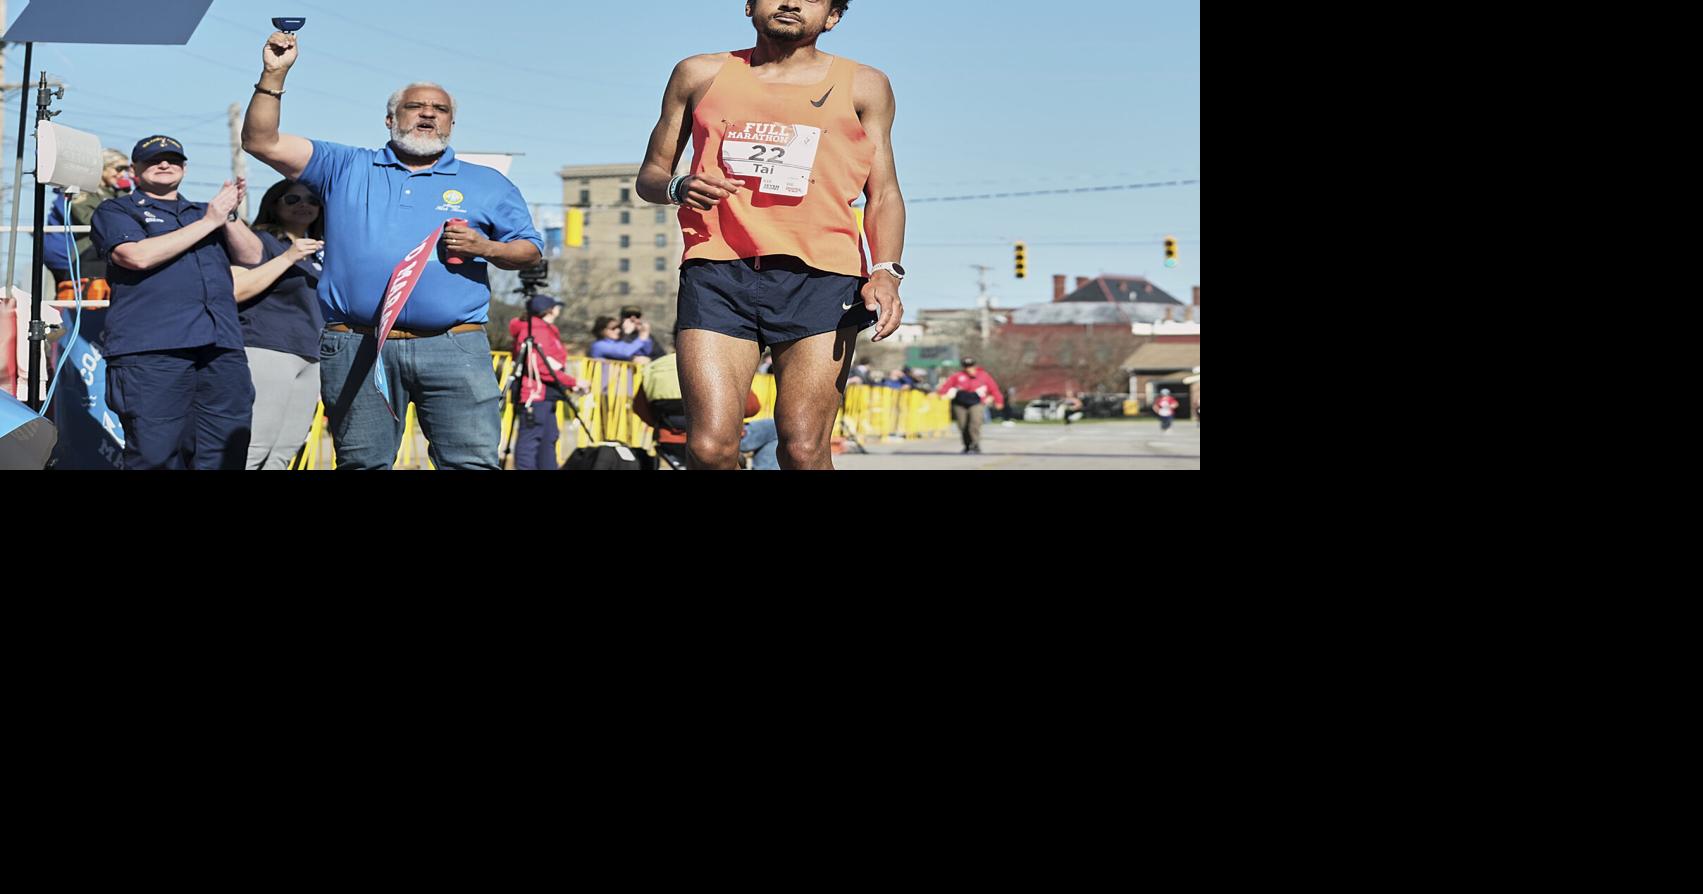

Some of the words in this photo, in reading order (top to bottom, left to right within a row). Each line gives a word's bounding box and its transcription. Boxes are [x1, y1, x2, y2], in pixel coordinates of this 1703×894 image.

[743, 122, 789, 137] FULL
[727, 131, 790, 144] MARATHON
[748, 145, 786, 164] 22
[753, 163, 775, 175] Tai
